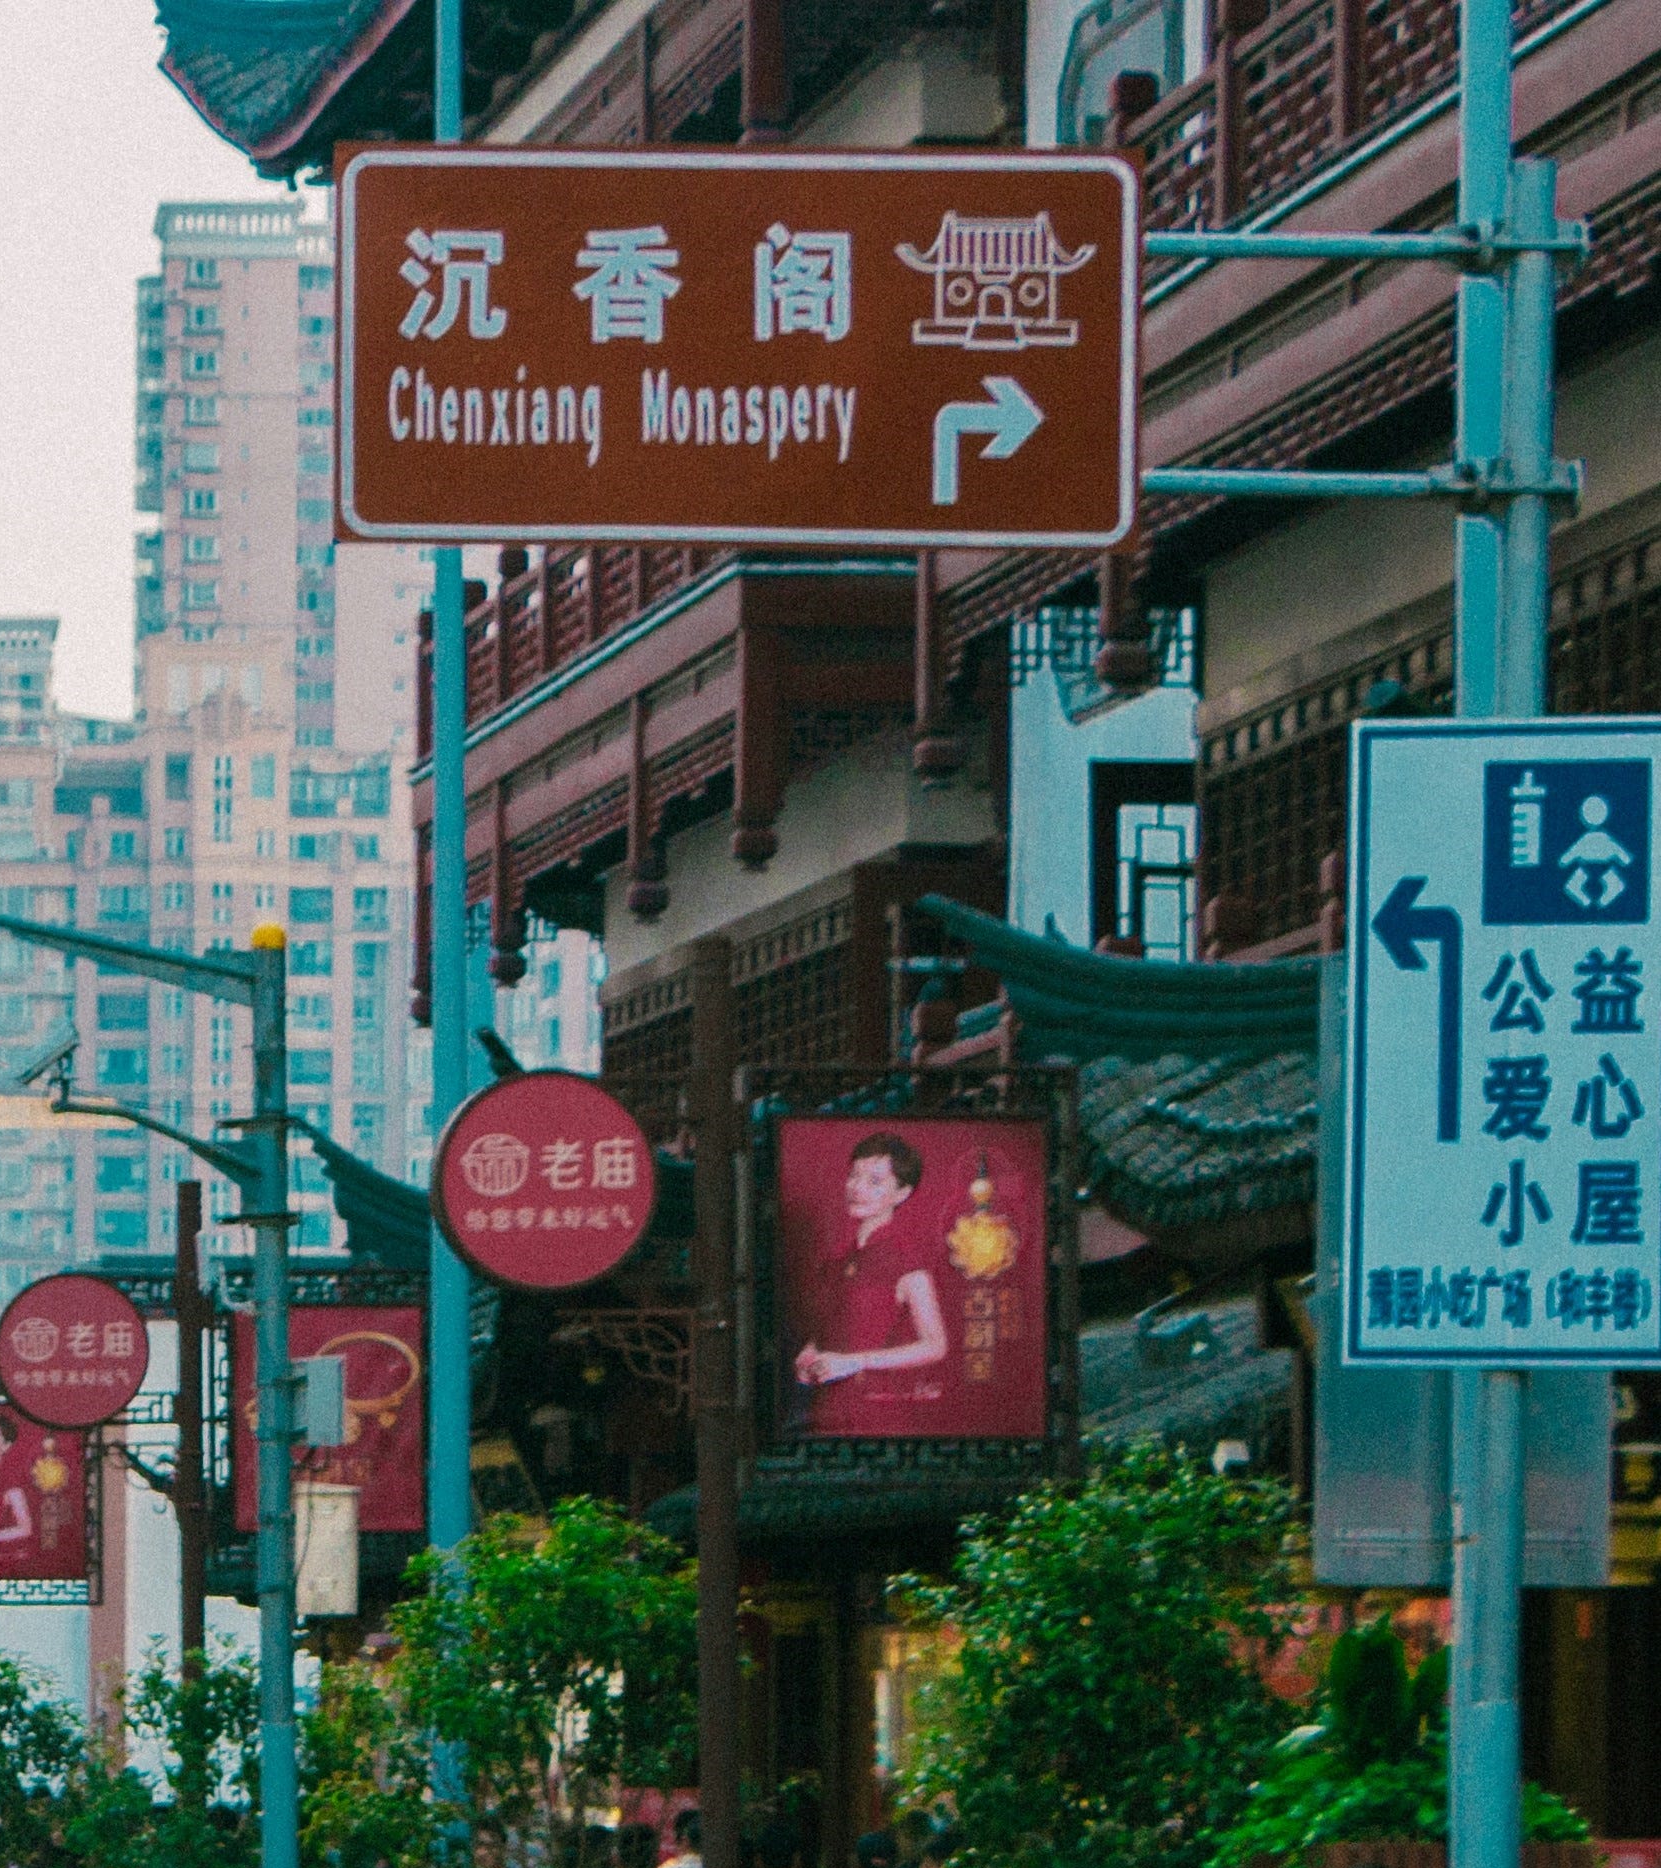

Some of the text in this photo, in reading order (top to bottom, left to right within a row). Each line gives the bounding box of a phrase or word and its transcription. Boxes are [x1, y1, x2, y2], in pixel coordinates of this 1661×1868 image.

[397, 221, 855, 345] 沉香阁
[388, 366, 858, 468] Chenxiang Monaspery
[1482, 946, 1645, 1036] 公益
[1481, 1052, 1646, 1143] 爱心
[538, 1135, 639, 1192] 老庙
[1479, 1158, 1645, 1248] 小屋
[65, 1320, 136, 1360] 老庙
